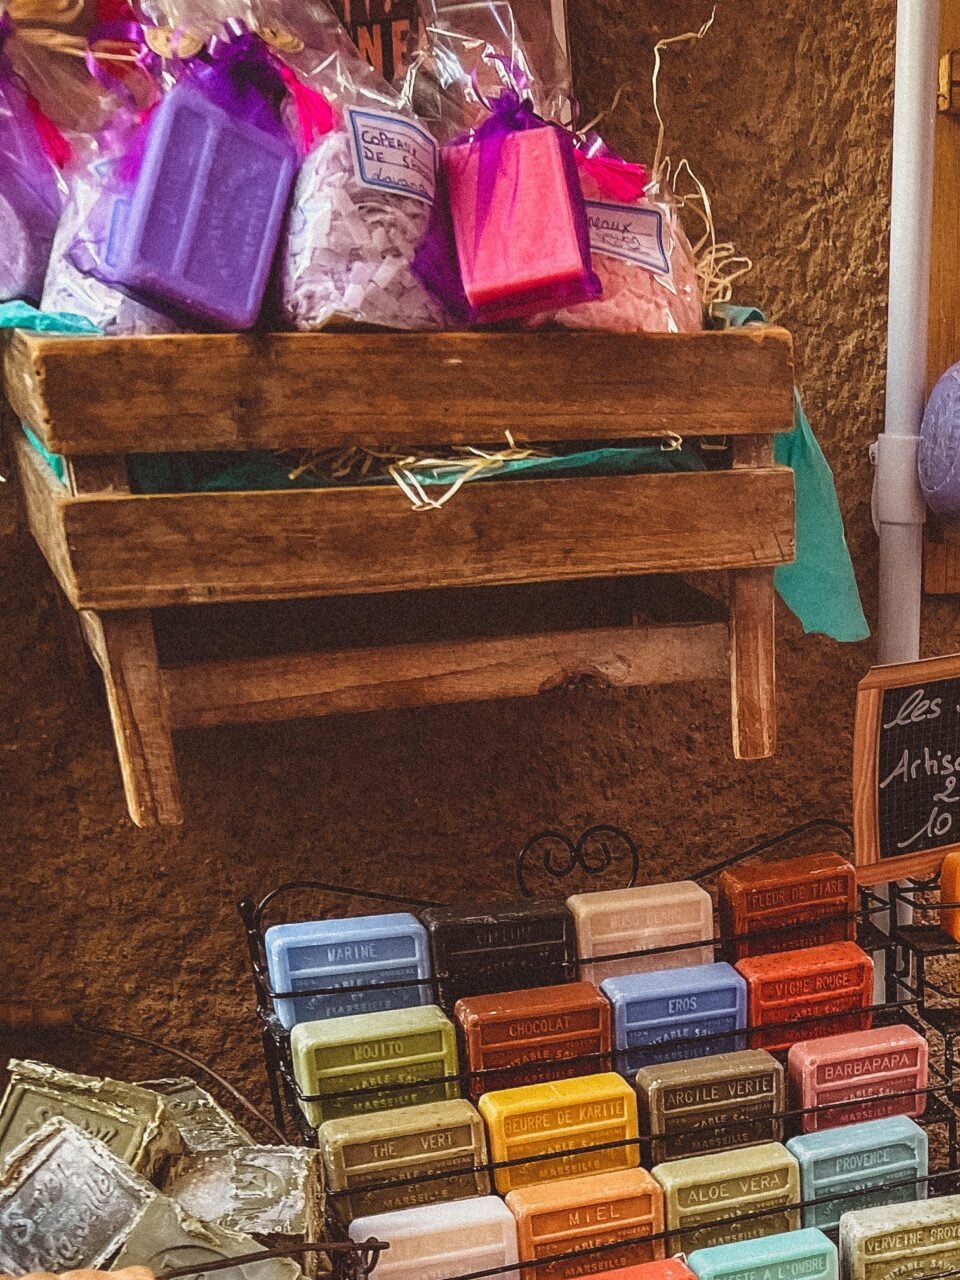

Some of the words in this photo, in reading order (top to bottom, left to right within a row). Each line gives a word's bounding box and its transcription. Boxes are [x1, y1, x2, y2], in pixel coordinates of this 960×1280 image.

[811, 879, 846, 900] TIARE
[327, 943, 378, 962] MARINE
[775, 977, 813, 997] VIGNE
[816, 973, 850, 990] ROUGE
[667, 997, 697, 1014] EROS
[509, 1017, 571, 1037] CHOCOLAT
[353, 1041, 404, 1061] MOJITO
[823, 1054, 911, 1080] BARBAPAPA
[666, 1086, 719, 1107] ARGILE
[727, 1076, 771, 1097] VERTE
[504, 1112, 551, 1133] BEURRE
[556, 1110, 573, 1125] DE
[578, 1100, 624, 1122] KARITE
[371, 1141, 397, 1158] THE
[419, 1130, 454, 1150] VERT
[835, 1149, 891, 1172] PROVENCE
[687, 1182, 729, 1203] ALOE
[739, 1172, 781, 1193] VERA
[568, 1205, 621, 1227] MIEL
[866, 1229, 927, 1253] VERVEINE
